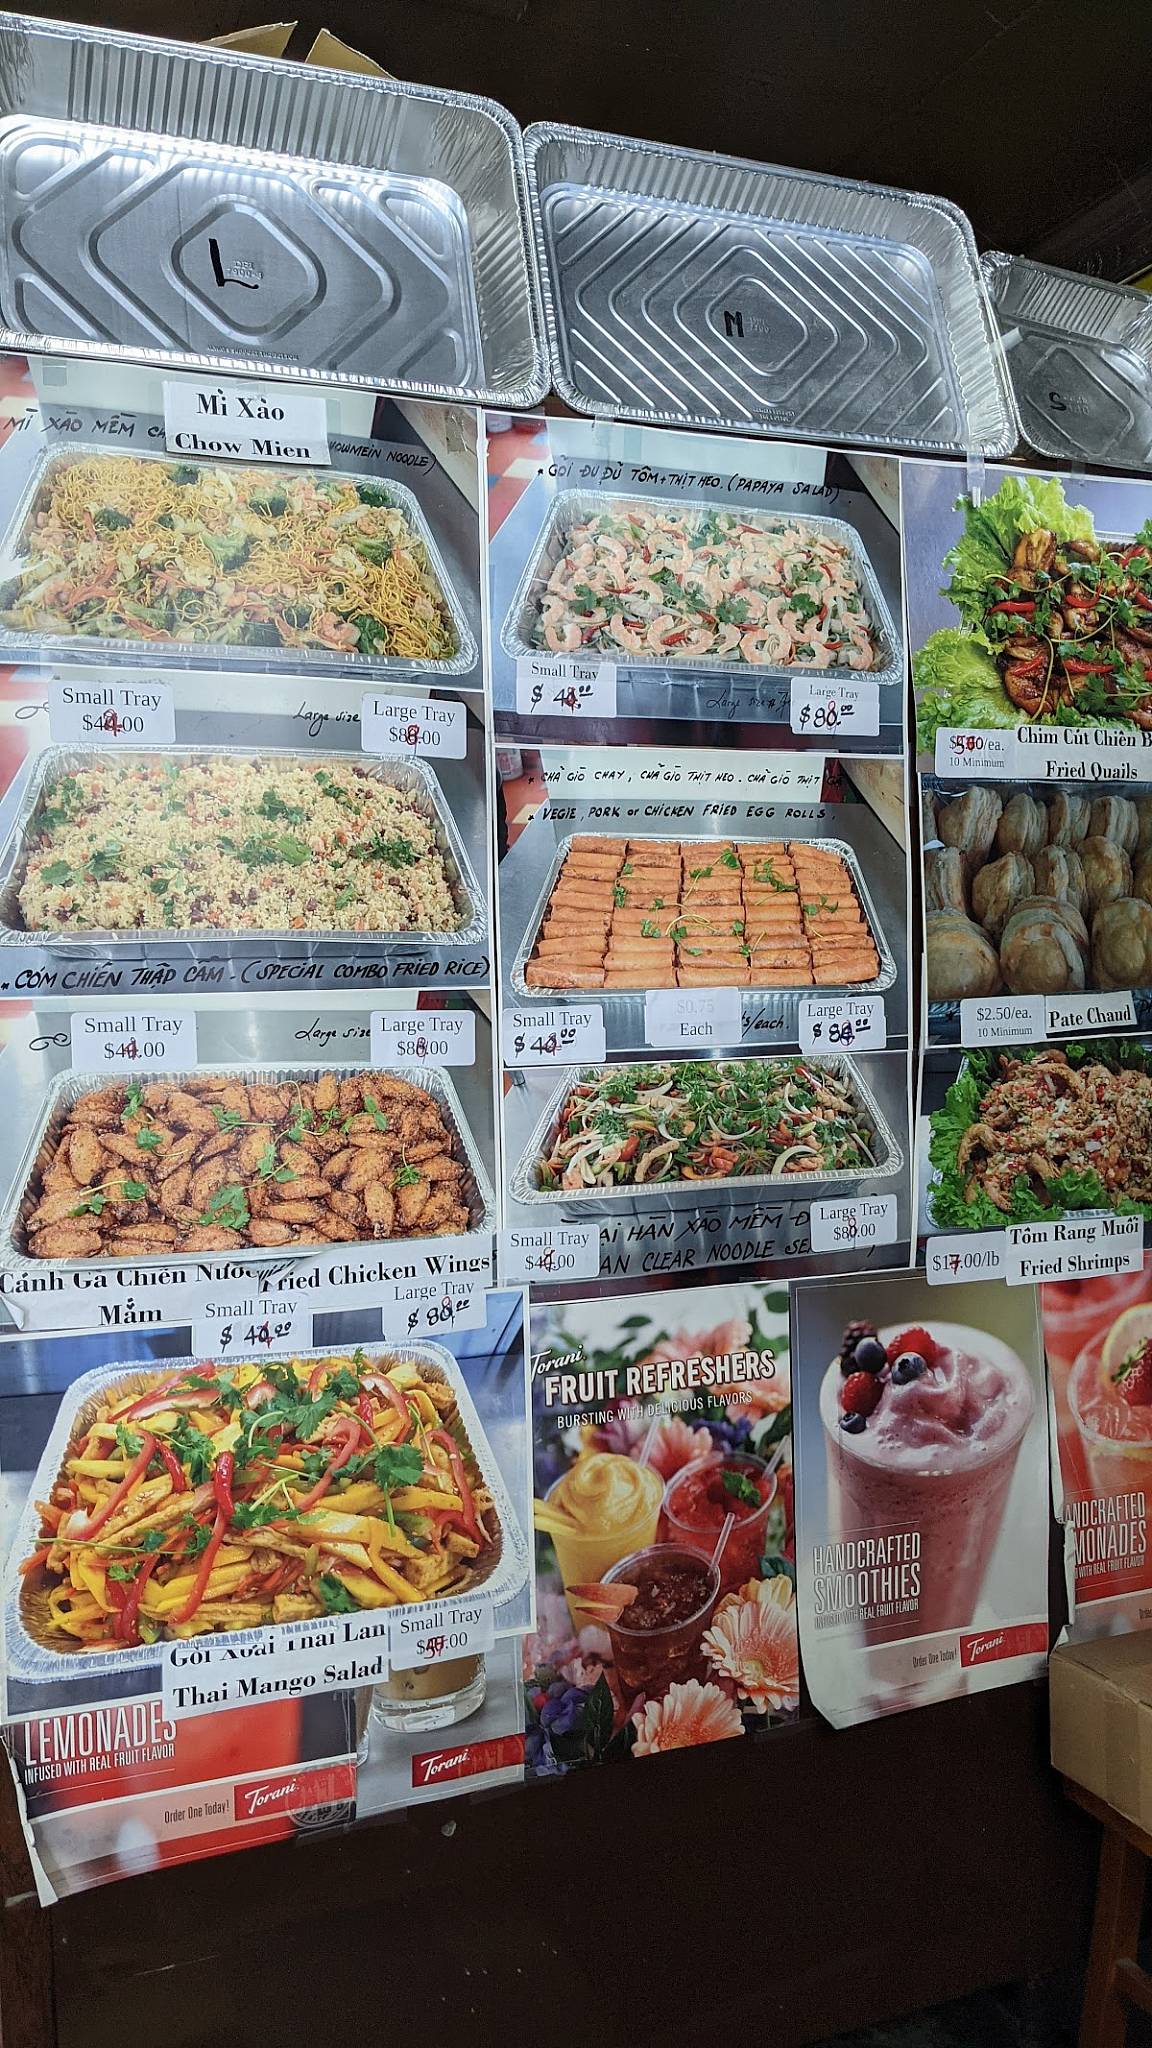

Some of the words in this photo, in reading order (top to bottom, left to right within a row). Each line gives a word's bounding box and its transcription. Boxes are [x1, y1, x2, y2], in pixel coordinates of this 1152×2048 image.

[208, 238, 259, 289] L
[724, 311, 744, 337] M
[235, 398, 284, 420] Xào
[1049, 392, 1066, 411] S
[175, 432, 241, 454] Chow
[250, 438, 312, 459] Mien
[531, 662, 566, 678] Small
[570, 665, 599, 680] Tray
[63, 688, 114, 705] Small
[120, 690, 161, 711] Tray
[810, 685, 836, 698] Large
[839, 687, 859, 700] Tray
[373, 701, 417, 724] Large
[422, 706, 455, 726] Tray
[1018, 726, 1057, 745] Chim
[1064, 728, 1089, 745] Cút
[1094, 729, 1136, 746] Chiên
[950, 757, 960, 767] 10
[963, 757, 1004, 768] Minimum
[1046, 761, 1085, 778] Fried
[1091, 762, 1138, 780] Quails
[588, 806, 620, 818] PORK
[628, 808, 640, 816] or
[645, 804, 695, 818] CHICKEN
[703, 803, 737, 816] FRIED
[746, 805, 776, 818] EGG
[333, 963, 388, 979] COMBO
[393, 958, 439, 977] FRIED
[444, 955, 490, 978] RICE)
[513, 1012, 554, 1027] Small
[560, 1011, 592, 1026] Tray
[808, 1003, 843, 1018] Large
[847, 1002, 874, 1017] Tray
[976, 1006, 1032, 1022] $2.50/ea.
[1048, 1010, 1083, 1028] Pate
[1087, 1005, 1131, 1024] Chaud
[85, 1017, 136, 1033] Small
[142, 1016, 183, 1035] Tray
[381, 1017, 425, 1038] Large
[429, 1017, 464, 1035] Tray
[680, 1021, 713, 1035] Each
[978, 1027, 988, 1037] 10
[991, 1027, 1032, 1037] Minimum
[820, 1207, 856, 1222] Large
[860, 1203, 888, 1218] Tray
[511, 1232, 552, 1247] Small
[558, 1232, 589, 1247] Tray
[1010, 1227, 1048, 1245] Tôm
[1054, 1225, 1096, 1243] Rang
[642, 1249, 696, 1272] CLEAR
[706, 1240, 775, 1263] NOODLE
[1020, 1257, 1062, 1277] Fried
[1068, 1253, 1130, 1272] Shrimps
[1, 1271, 64, 1293] Cánh
[329, 1261, 416, 1286] Chicken
[425, 1254, 489, 1275] Wings
[394, 1286, 437, 1300] Large
[205, 1300, 253, 1318] Small
[544, 1369, 618, 1407] FRUIT
[626, 1349, 776, 1396] REFRESHERS
[557, 1410, 614, 1429] BURSTING
[618, 1406, 644, 1419] WITH
[648, 1397, 703, 1416] DELICIOUS
[708, 1391, 752, 1409] FLAVORS
[1065, 1492, 1146, 1528] ANDCRAFTED
[814, 1532, 920, 1575] HANDCRAFTED
[814, 1562, 920, 1614] SMOOTHIES
[859, 1607, 875, 1621] REAL
[877, 1603, 894, 1617] FRUIT
[896, 1599, 919, 1613] FLAVOR
[343, 1622, 386, 1643] Lan
[401, 1612, 443, 1634] Small
[448, 1609, 482, 1625] Tray
[967, 1632, 1005, 1662] Torani
[173, 1682, 227, 1708] Thai
[236, 1673, 316, 1698] Mango
[323, 1655, 383, 1684] Salad
[25, 1763, 61, 1785] INFUSED
[63, 1759, 87, 1777] WITH
[90, 1755, 111, 1772] REAL
[114, 1750, 140, 1767] FRUIT
[142, 1743, 175, 1762] FLAVOR
[421, 1749, 469, 1781] Torani
[245, 1778, 297, 1814] Torani
[164, 1809, 185, 1823] Order
[187, 1806, 203, 1819] One
[204, 1800, 229, 1817] Today!
